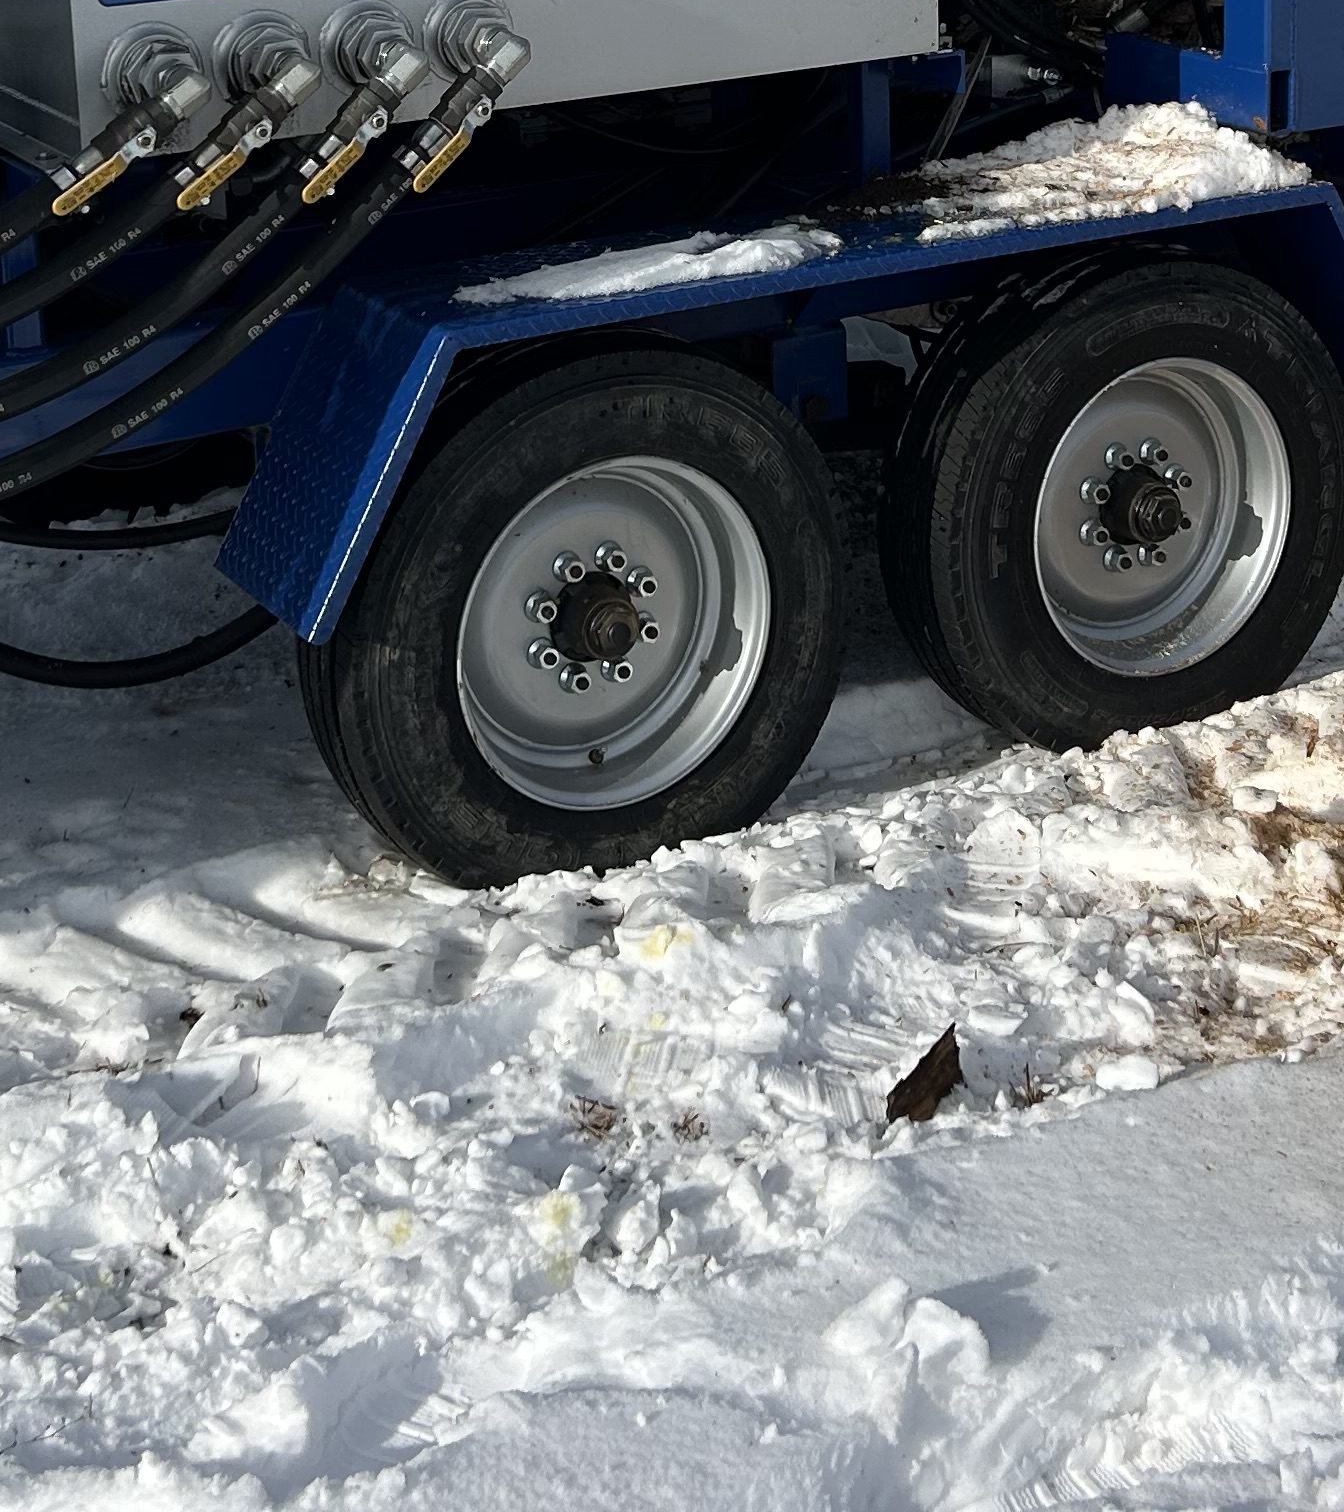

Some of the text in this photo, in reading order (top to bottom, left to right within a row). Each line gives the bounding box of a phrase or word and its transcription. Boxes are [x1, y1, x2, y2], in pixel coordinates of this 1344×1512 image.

[1, 228, 16, 242] R4
[85, 227, 142, 270] SAE 100 R4
[235, 214, 285, 263] SAE 100 R4
[262, 280, 311, 329] SAE 100 R4
[99, 324, 157, 365] SAE 100 R4
[128, 387, 184, 429] SAE 100 R4
[18, 472, 33, 484] R4
